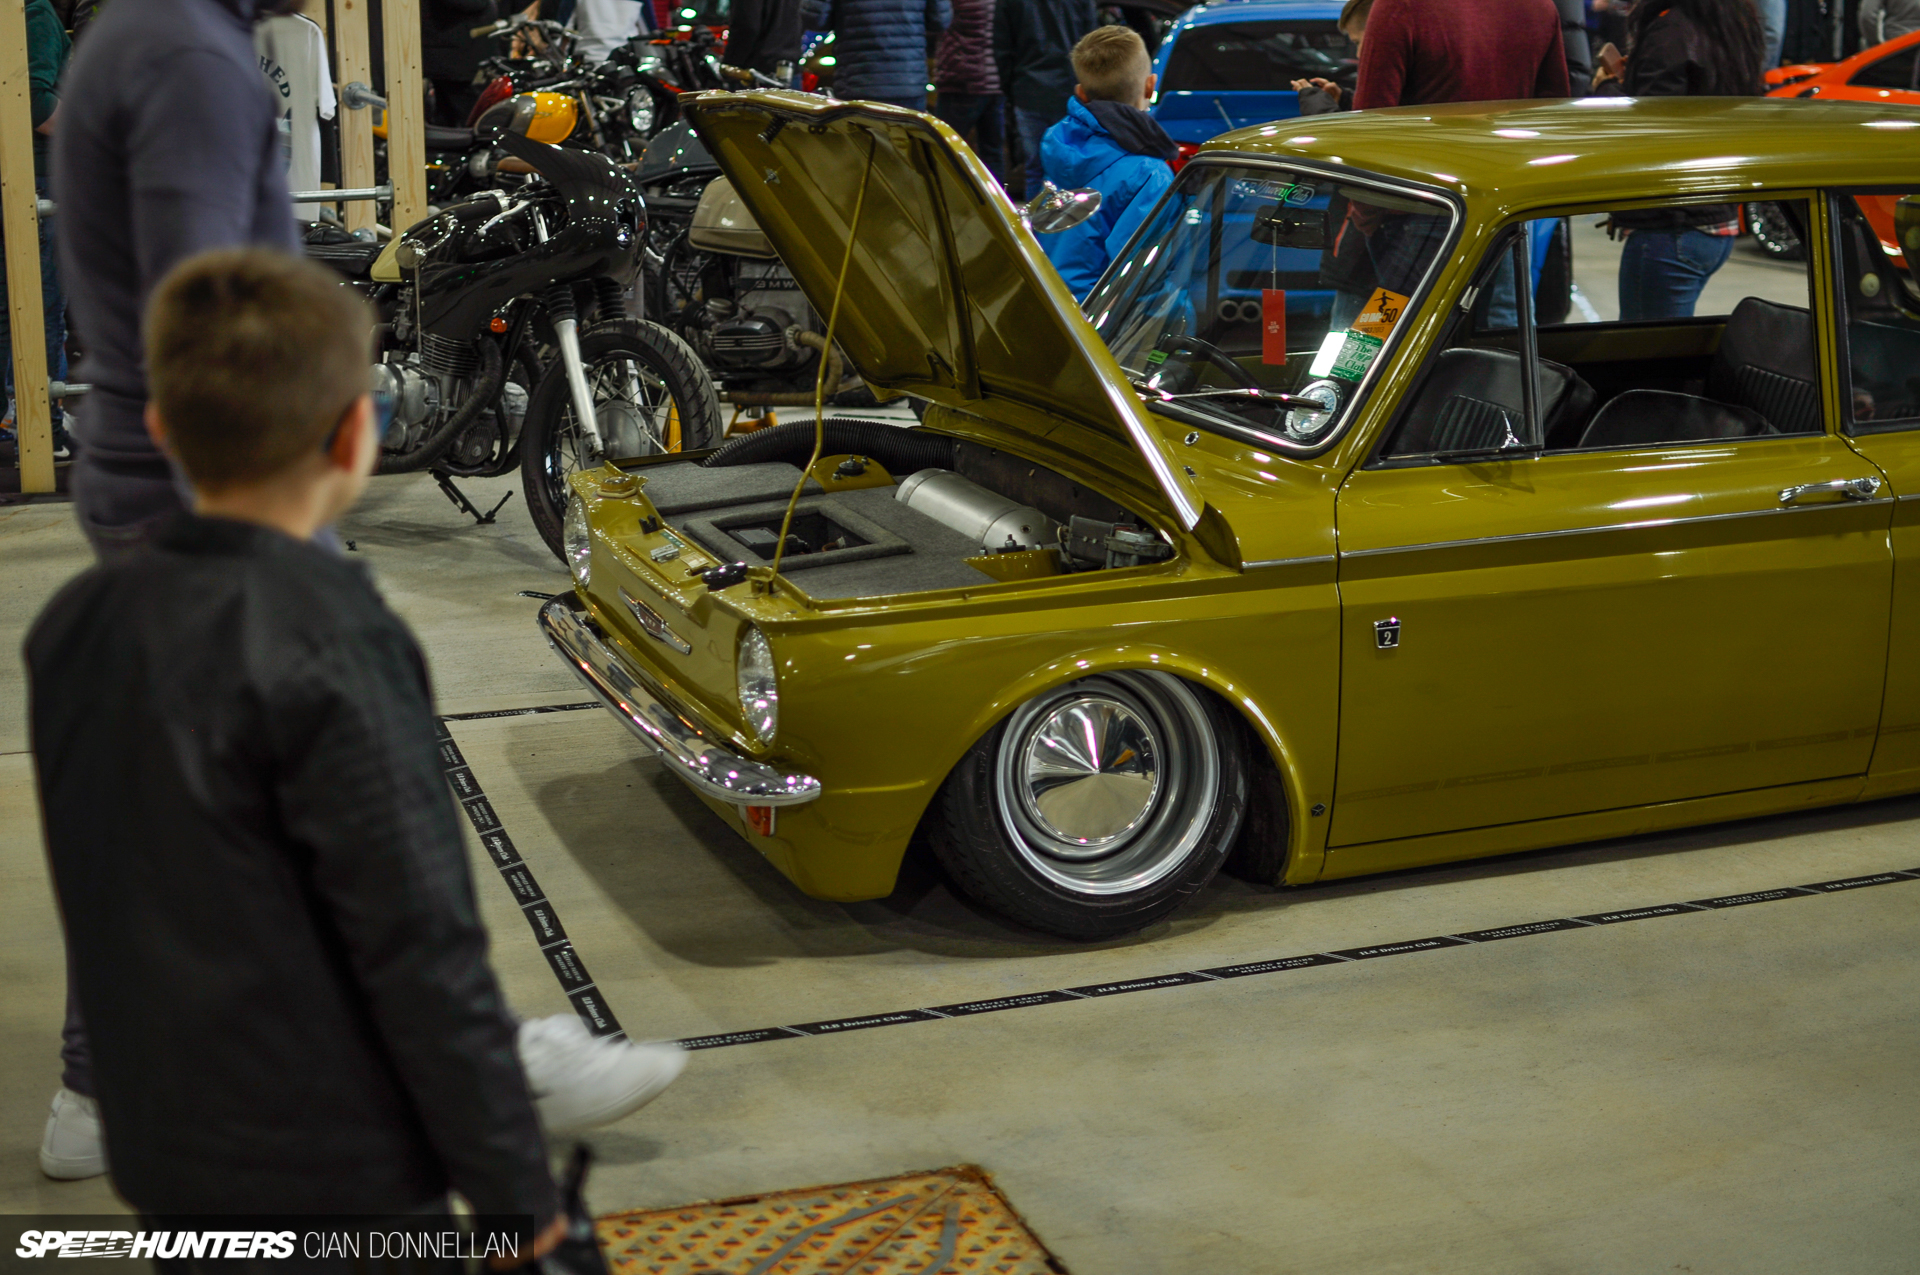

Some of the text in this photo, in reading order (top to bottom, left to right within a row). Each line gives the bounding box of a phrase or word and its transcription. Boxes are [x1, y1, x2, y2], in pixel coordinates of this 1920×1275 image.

[1380, 308, 1398, 323] 50
[1355, 344, 1373, 353] The
[1350, 351, 1373, 363] IMP
[1344, 360, 1366, 372] Club
[1383, 630, 1392, 645] 2
[1380, 944, 1414, 953] Drivers
[1120, 981, 1155, 990] Drivers
[843, 1018, 881, 1027] Drivers
